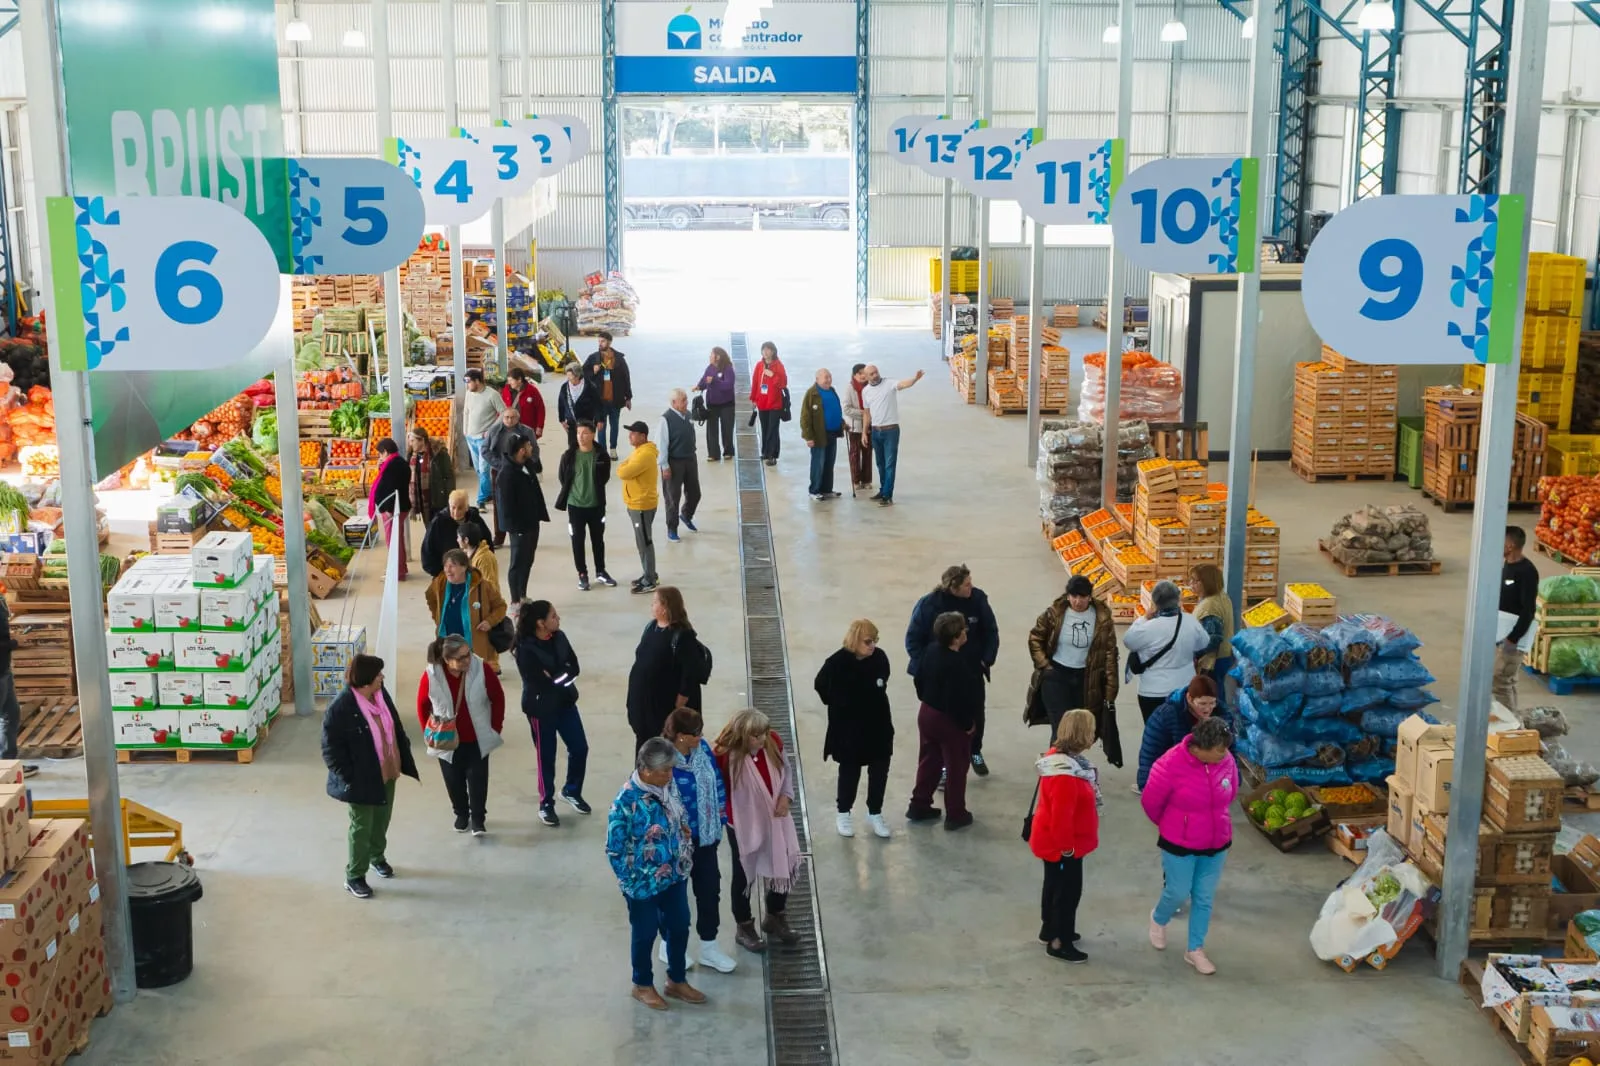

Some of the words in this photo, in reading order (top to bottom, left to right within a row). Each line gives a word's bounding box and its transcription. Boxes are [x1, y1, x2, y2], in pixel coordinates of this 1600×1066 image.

[694, 66, 777, 84] SALIDA
[492, 145, 519, 180] 3
[532, 133, 552, 164] 2
[925, 134, 963, 163] 13
[968, 145, 1013, 181] 12
[434, 159, 473, 203] 4
[1036, 161, 1082, 204] 11
[341, 186, 389, 246] 5
[1130, 187, 1211, 245] 10
[154, 240, 224, 325] 6
[1358, 238, 1424, 322] 9
